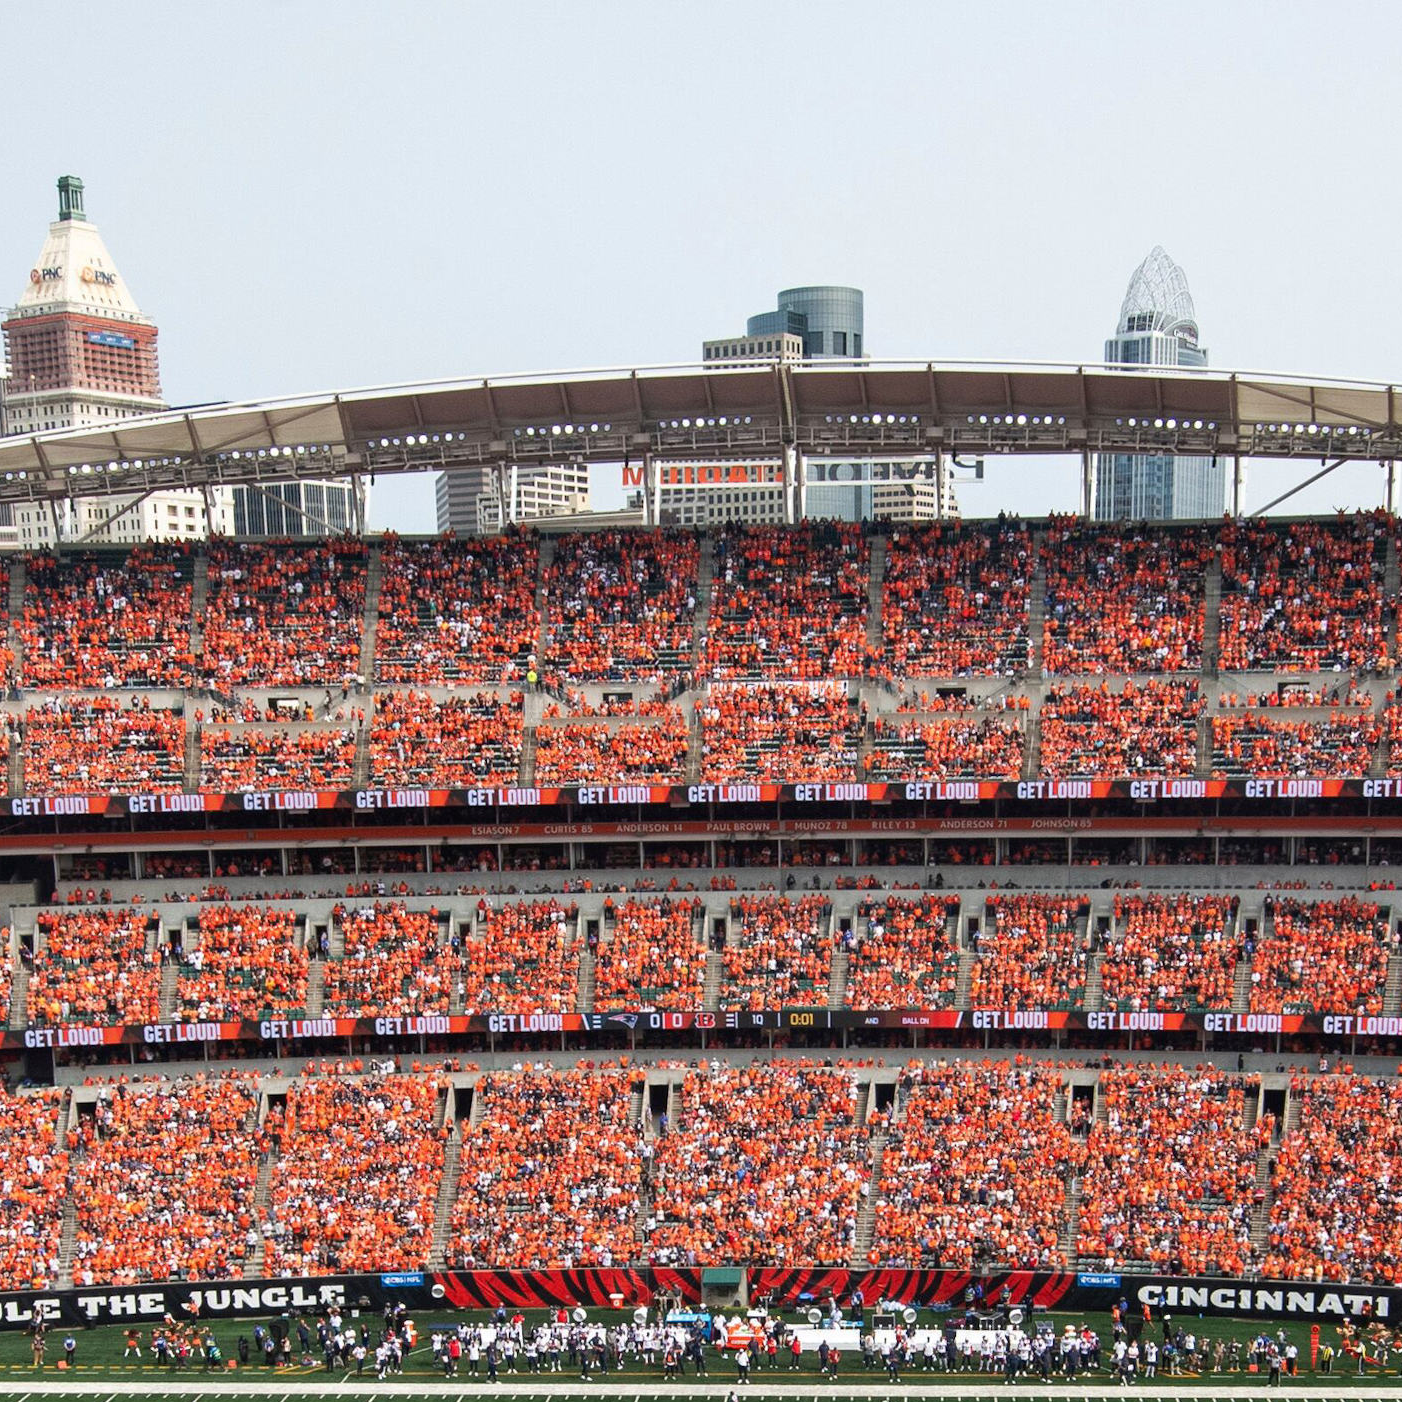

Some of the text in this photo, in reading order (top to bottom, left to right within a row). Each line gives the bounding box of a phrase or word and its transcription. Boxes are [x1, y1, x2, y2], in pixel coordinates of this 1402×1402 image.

[42, 267, 62, 279] PNC
[94, 271, 117, 284] PNC
[578, 785, 650, 803] GET LOUD!
[689, 783, 760, 802] GET LOUD!
[906, 781, 978, 799] GET LOUD!
[1131, 779, 1205, 797] GET LOUD!
[1246, 779, 1322, 797] GET LOUD!
[128, 791, 204, 812] GET LOUD!
[357, 789, 429, 807] GET LOUD!
[261, 1017, 337, 1038] GET LOUD!
[376, 1015, 450, 1034] GET LOUD!
[489, 1013, 562, 1032] GET LOUD!
[650, 1013, 660, 1028] 0
[672, 1013, 682, 1028] 0
[752, 1014, 764, 1025] 1Q
[790, 1013, 814, 1026] 0:01
[864, 1017, 879, 1025] AND
[902, 1017, 918, 1025] BALL
[973, 1010, 1047, 1028] GET LOUD!
[1088, 1011, 1163, 1030] GET LOUD!
[1324, 1016, 1402, 1034] GET LOUD!
[145, 1021, 220, 1042] GET LOUD!
[78, 1293, 165, 1317] THE
[181, 1285, 346, 1312] JUNGLE
[1138, 1285, 1389, 1317] CINCINNATI
